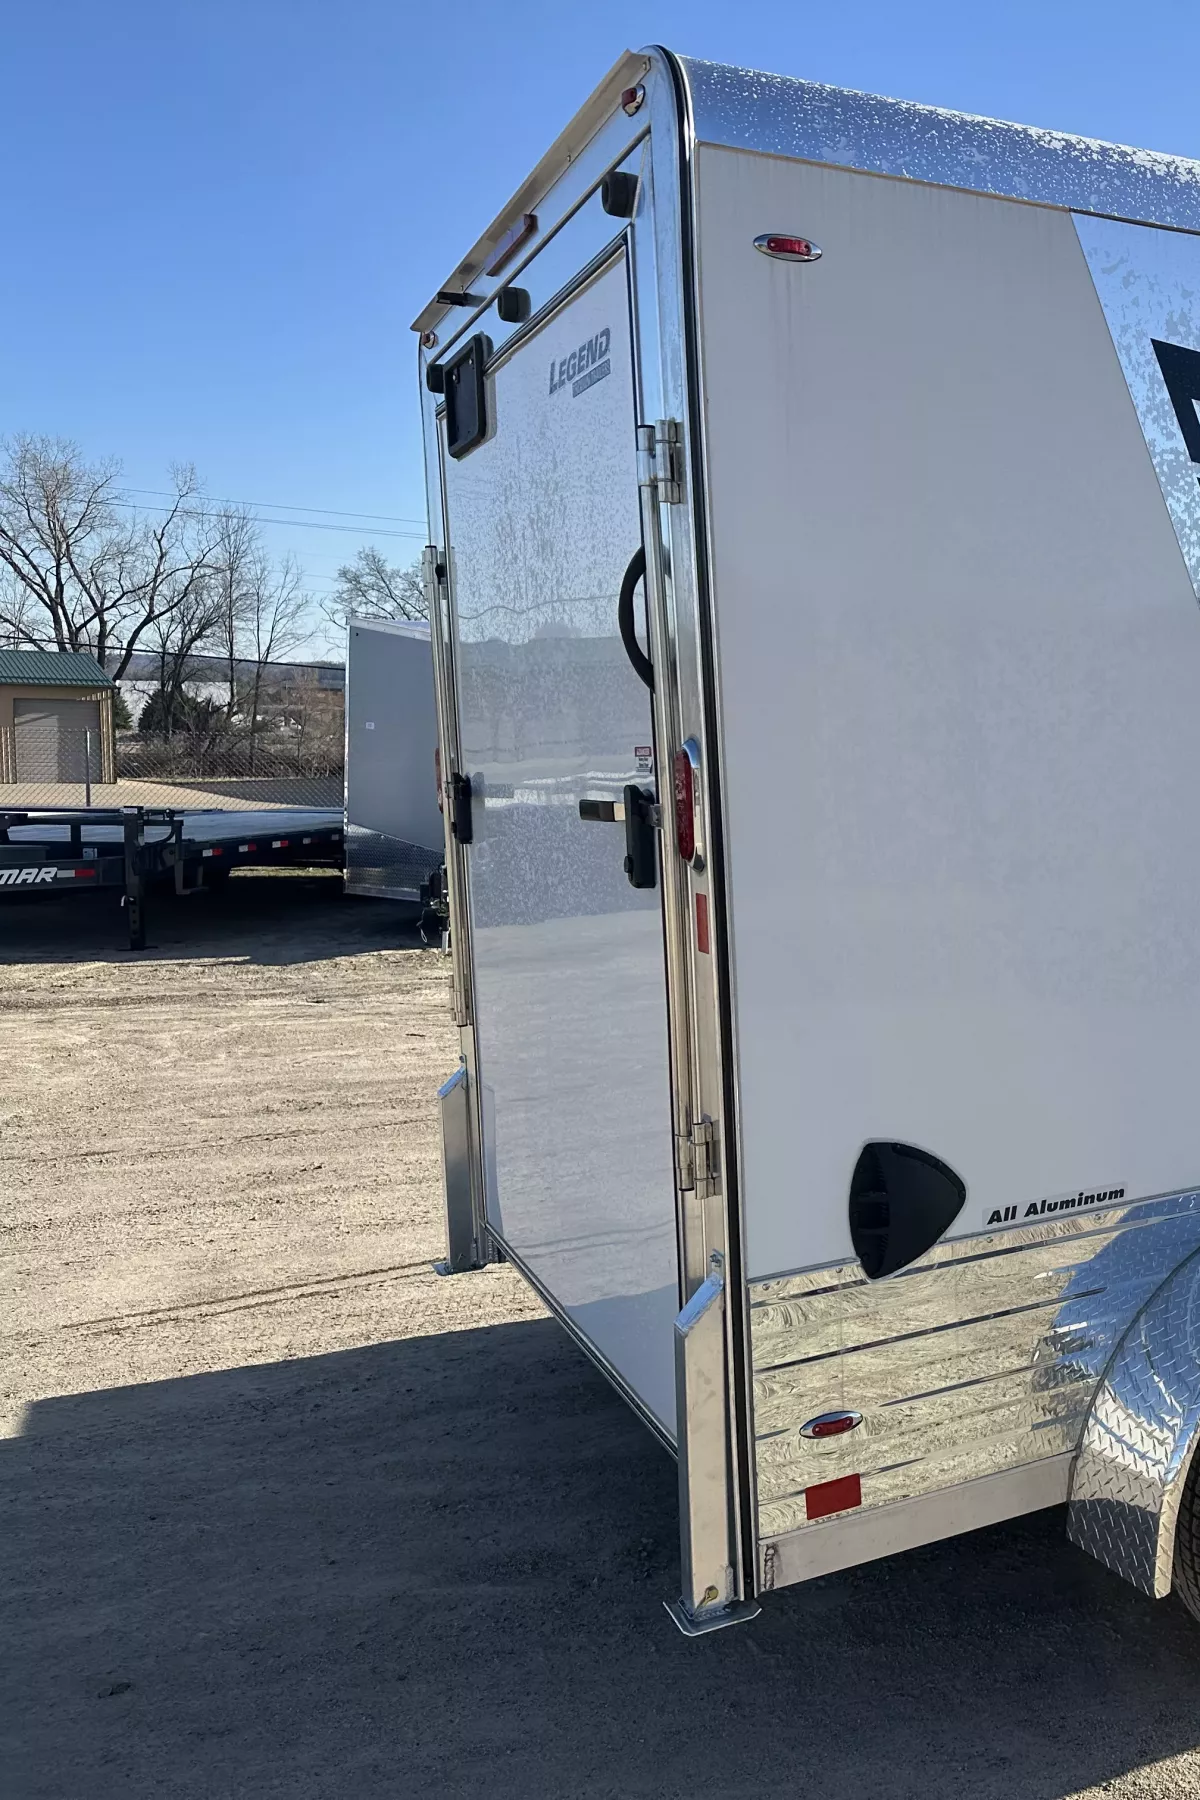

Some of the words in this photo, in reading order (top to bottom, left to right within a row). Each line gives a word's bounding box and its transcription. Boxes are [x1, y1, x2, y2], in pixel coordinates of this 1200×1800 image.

[549, 327, 611, 395] LEGEND
[986, 1205, 1018, 1225] All
[1023, 1188, 1125, 1218] Aluminum
